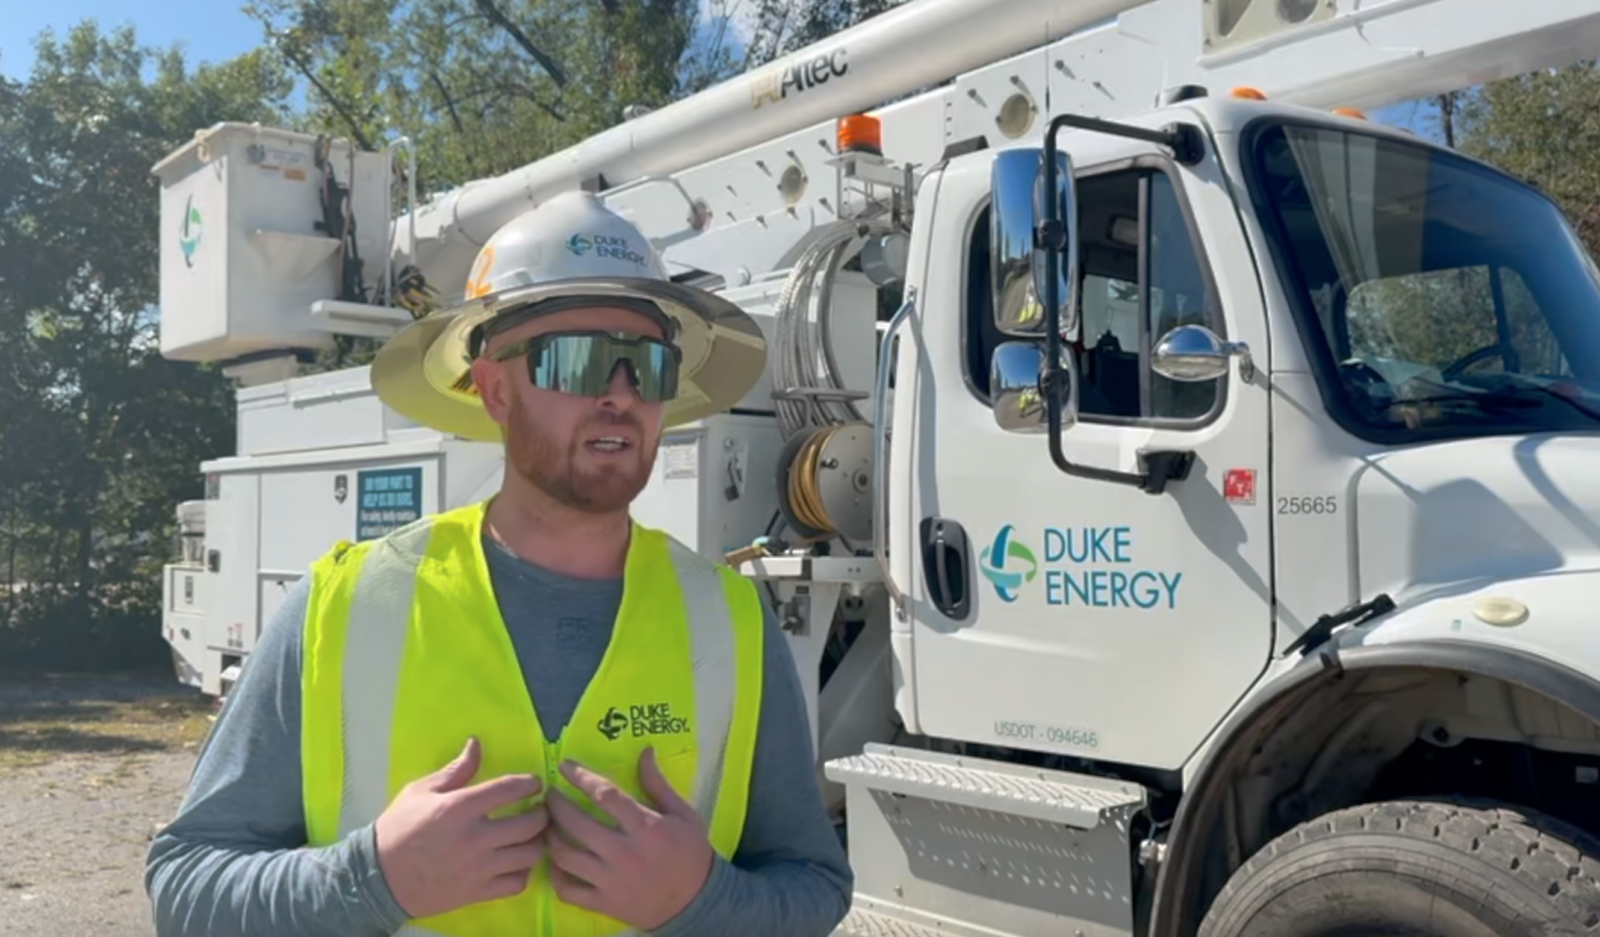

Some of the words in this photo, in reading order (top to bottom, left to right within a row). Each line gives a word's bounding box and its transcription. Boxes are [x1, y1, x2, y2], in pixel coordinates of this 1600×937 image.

[781, 48, 848, 99] Altec
[593, 234, 628, 249] DUKE
[1277, 495, 1338, 515] 25665
[1044, 527, 1132, 563] DUKE
[1045, 571, 1183, 609] ENERGY
[630, 702, 670, 721] DUKE
[994, 721, 1036, 739] USDOT
[1046, 726, 1099, 748] 094646
